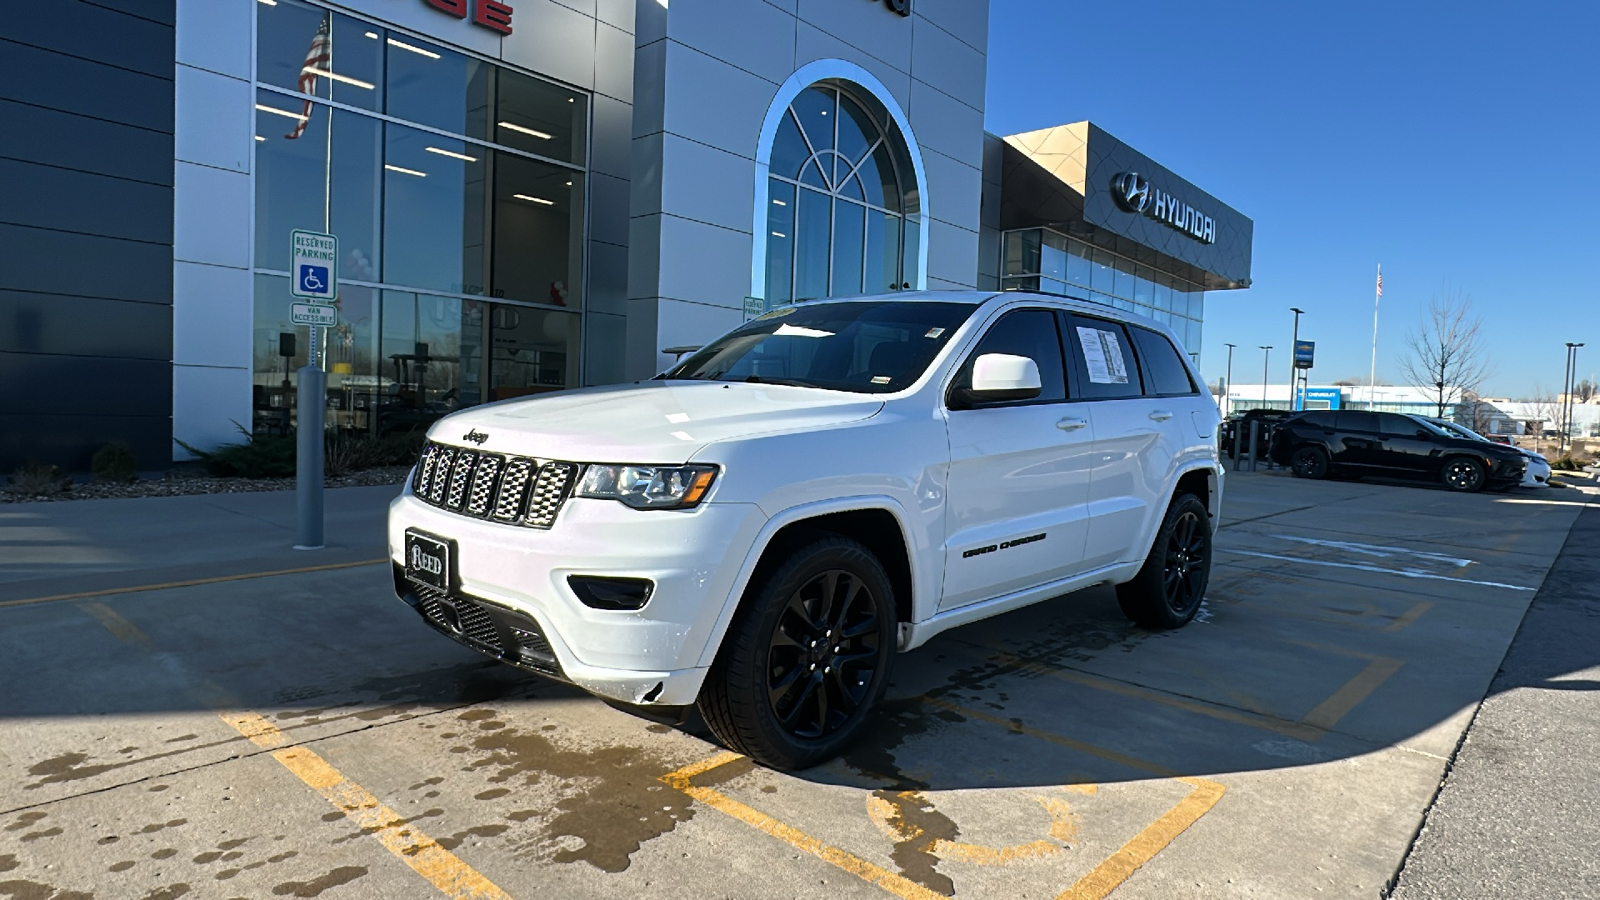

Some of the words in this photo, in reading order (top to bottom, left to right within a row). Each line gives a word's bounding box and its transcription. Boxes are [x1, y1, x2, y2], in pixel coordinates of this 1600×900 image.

[1154, 188, 1216, 244] HYUNDAI
[296, 236, 333, 250] RESERVED
[295, 248, 334, 261] PARKING
[307, 307, 321, 315] VAN
[294, 313, 334, 324] ACCESSIBLE
[463, 428, 489, 446] Jeep
[963, 545, 997, 558] GRAND
[411, 544, 442, 575] REED
